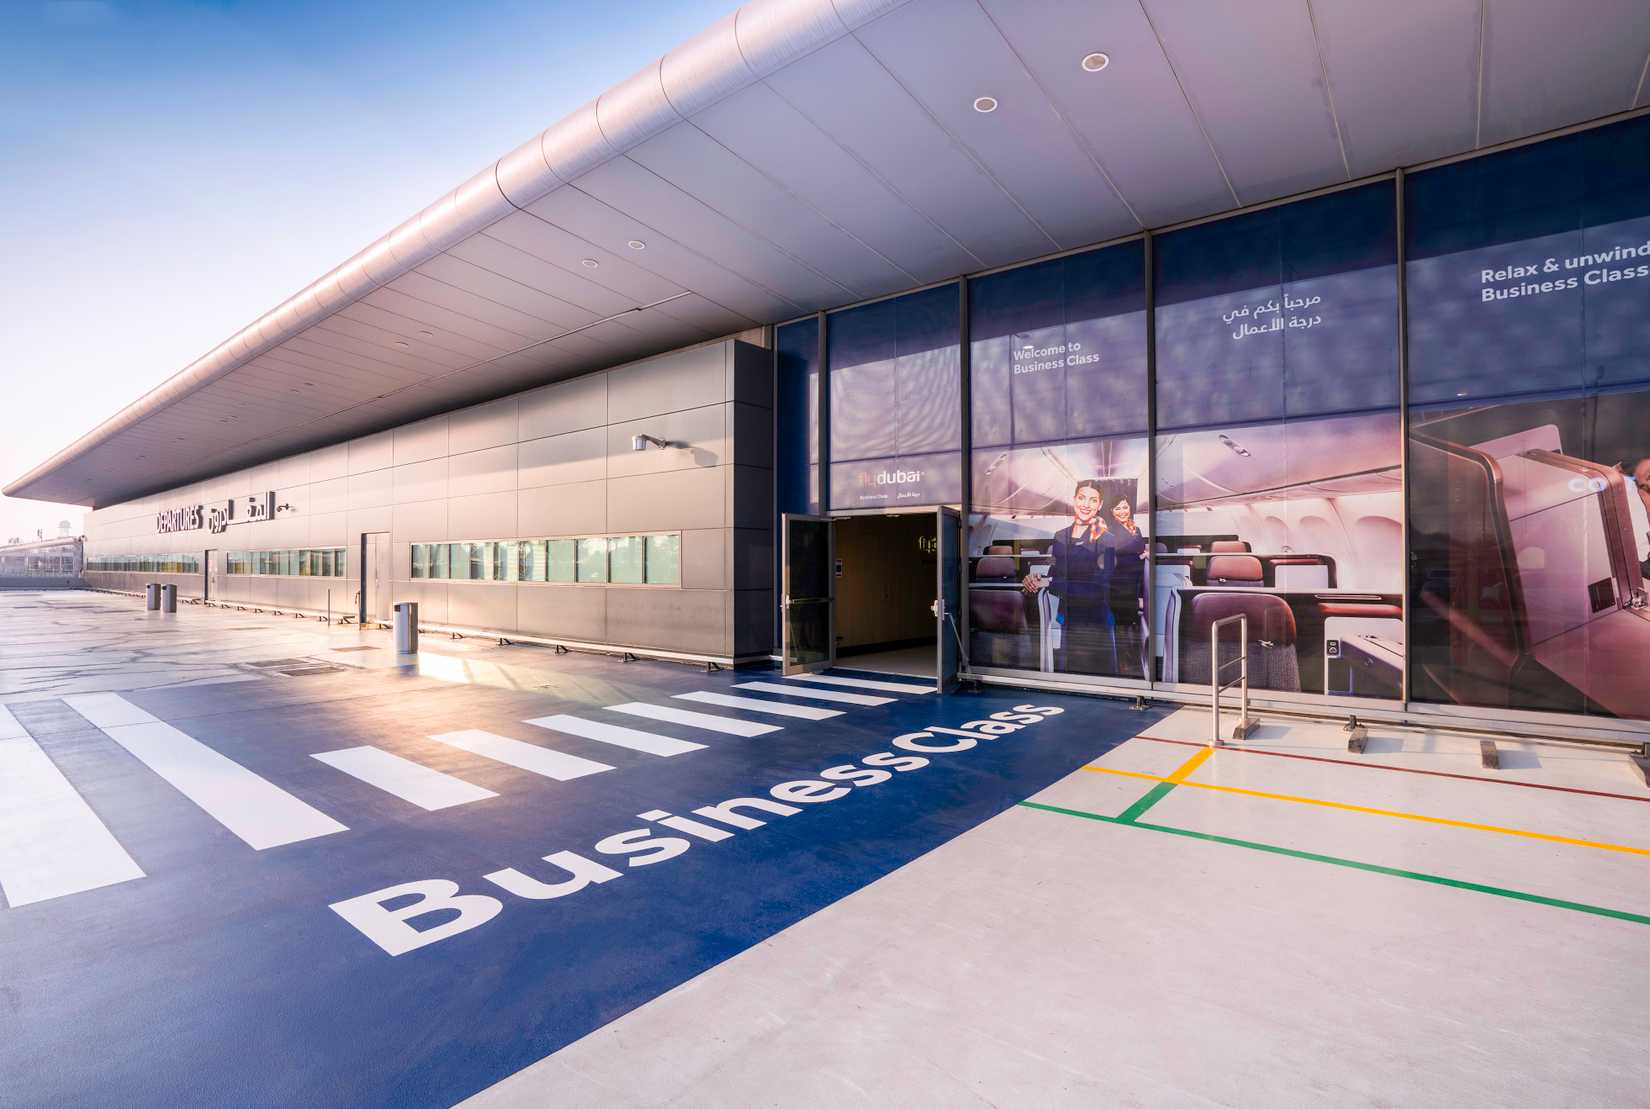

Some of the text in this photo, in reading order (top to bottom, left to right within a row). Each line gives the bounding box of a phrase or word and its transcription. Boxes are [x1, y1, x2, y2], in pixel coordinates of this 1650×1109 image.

[1481, 240, 1650, 283] Relax & unwind
[1481, 265, 1649, 302] Business Class
[1223, 305, 1249, 324] في
[1253, 300, 1280, 319] بكم
[1288, 316, 1321, 329] درجة
[1013, 342, 1081, 361] Welcome to
[1013, 353, 1100, 375] Business Class
[156, 505, 202, 533] DEPARTURES
[329, 704, 1065, 957] Business Class
